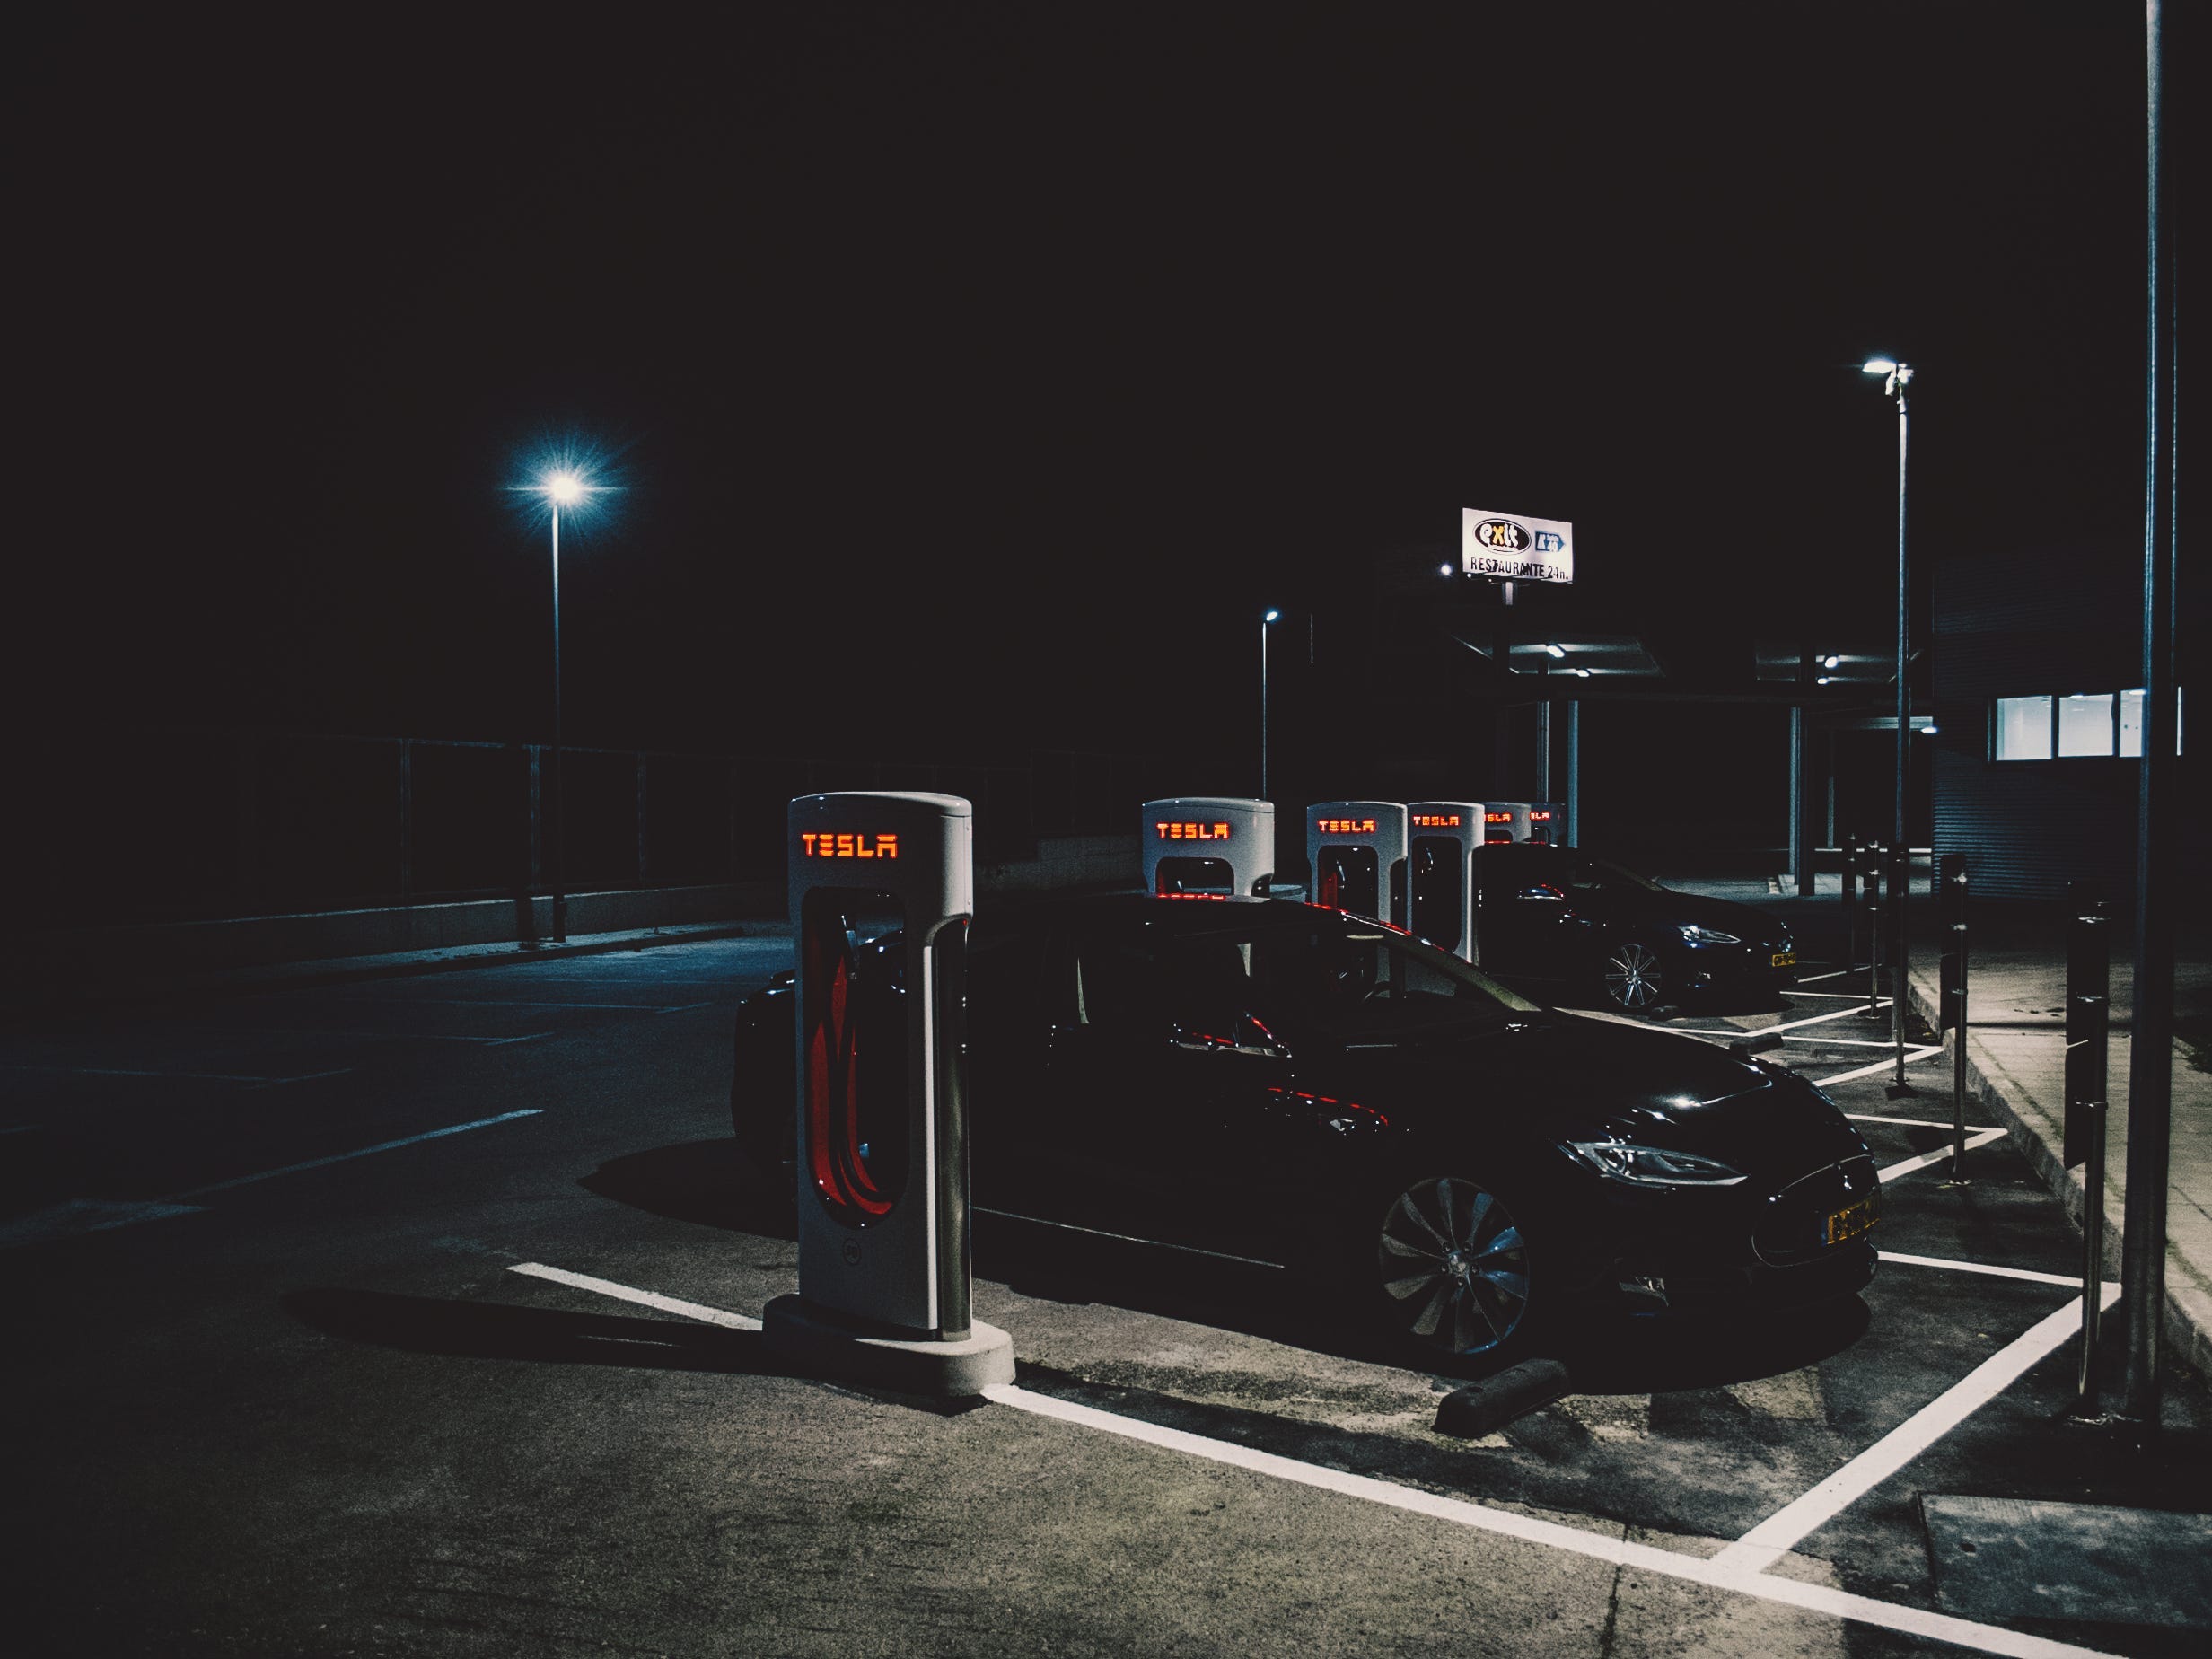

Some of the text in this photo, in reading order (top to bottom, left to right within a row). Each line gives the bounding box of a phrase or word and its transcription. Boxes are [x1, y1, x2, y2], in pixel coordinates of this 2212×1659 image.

[1470, 557, 1545, 577] RESTAURANTE
[1412, 815, 1460, 826] TESLA
[1484, 812, 1512, 822] SLA
[1156, 822, 1230, 839] TESLA
[1318, 819, 1376, 833] TESLA
[803, 833, 897, 858] TESLA
